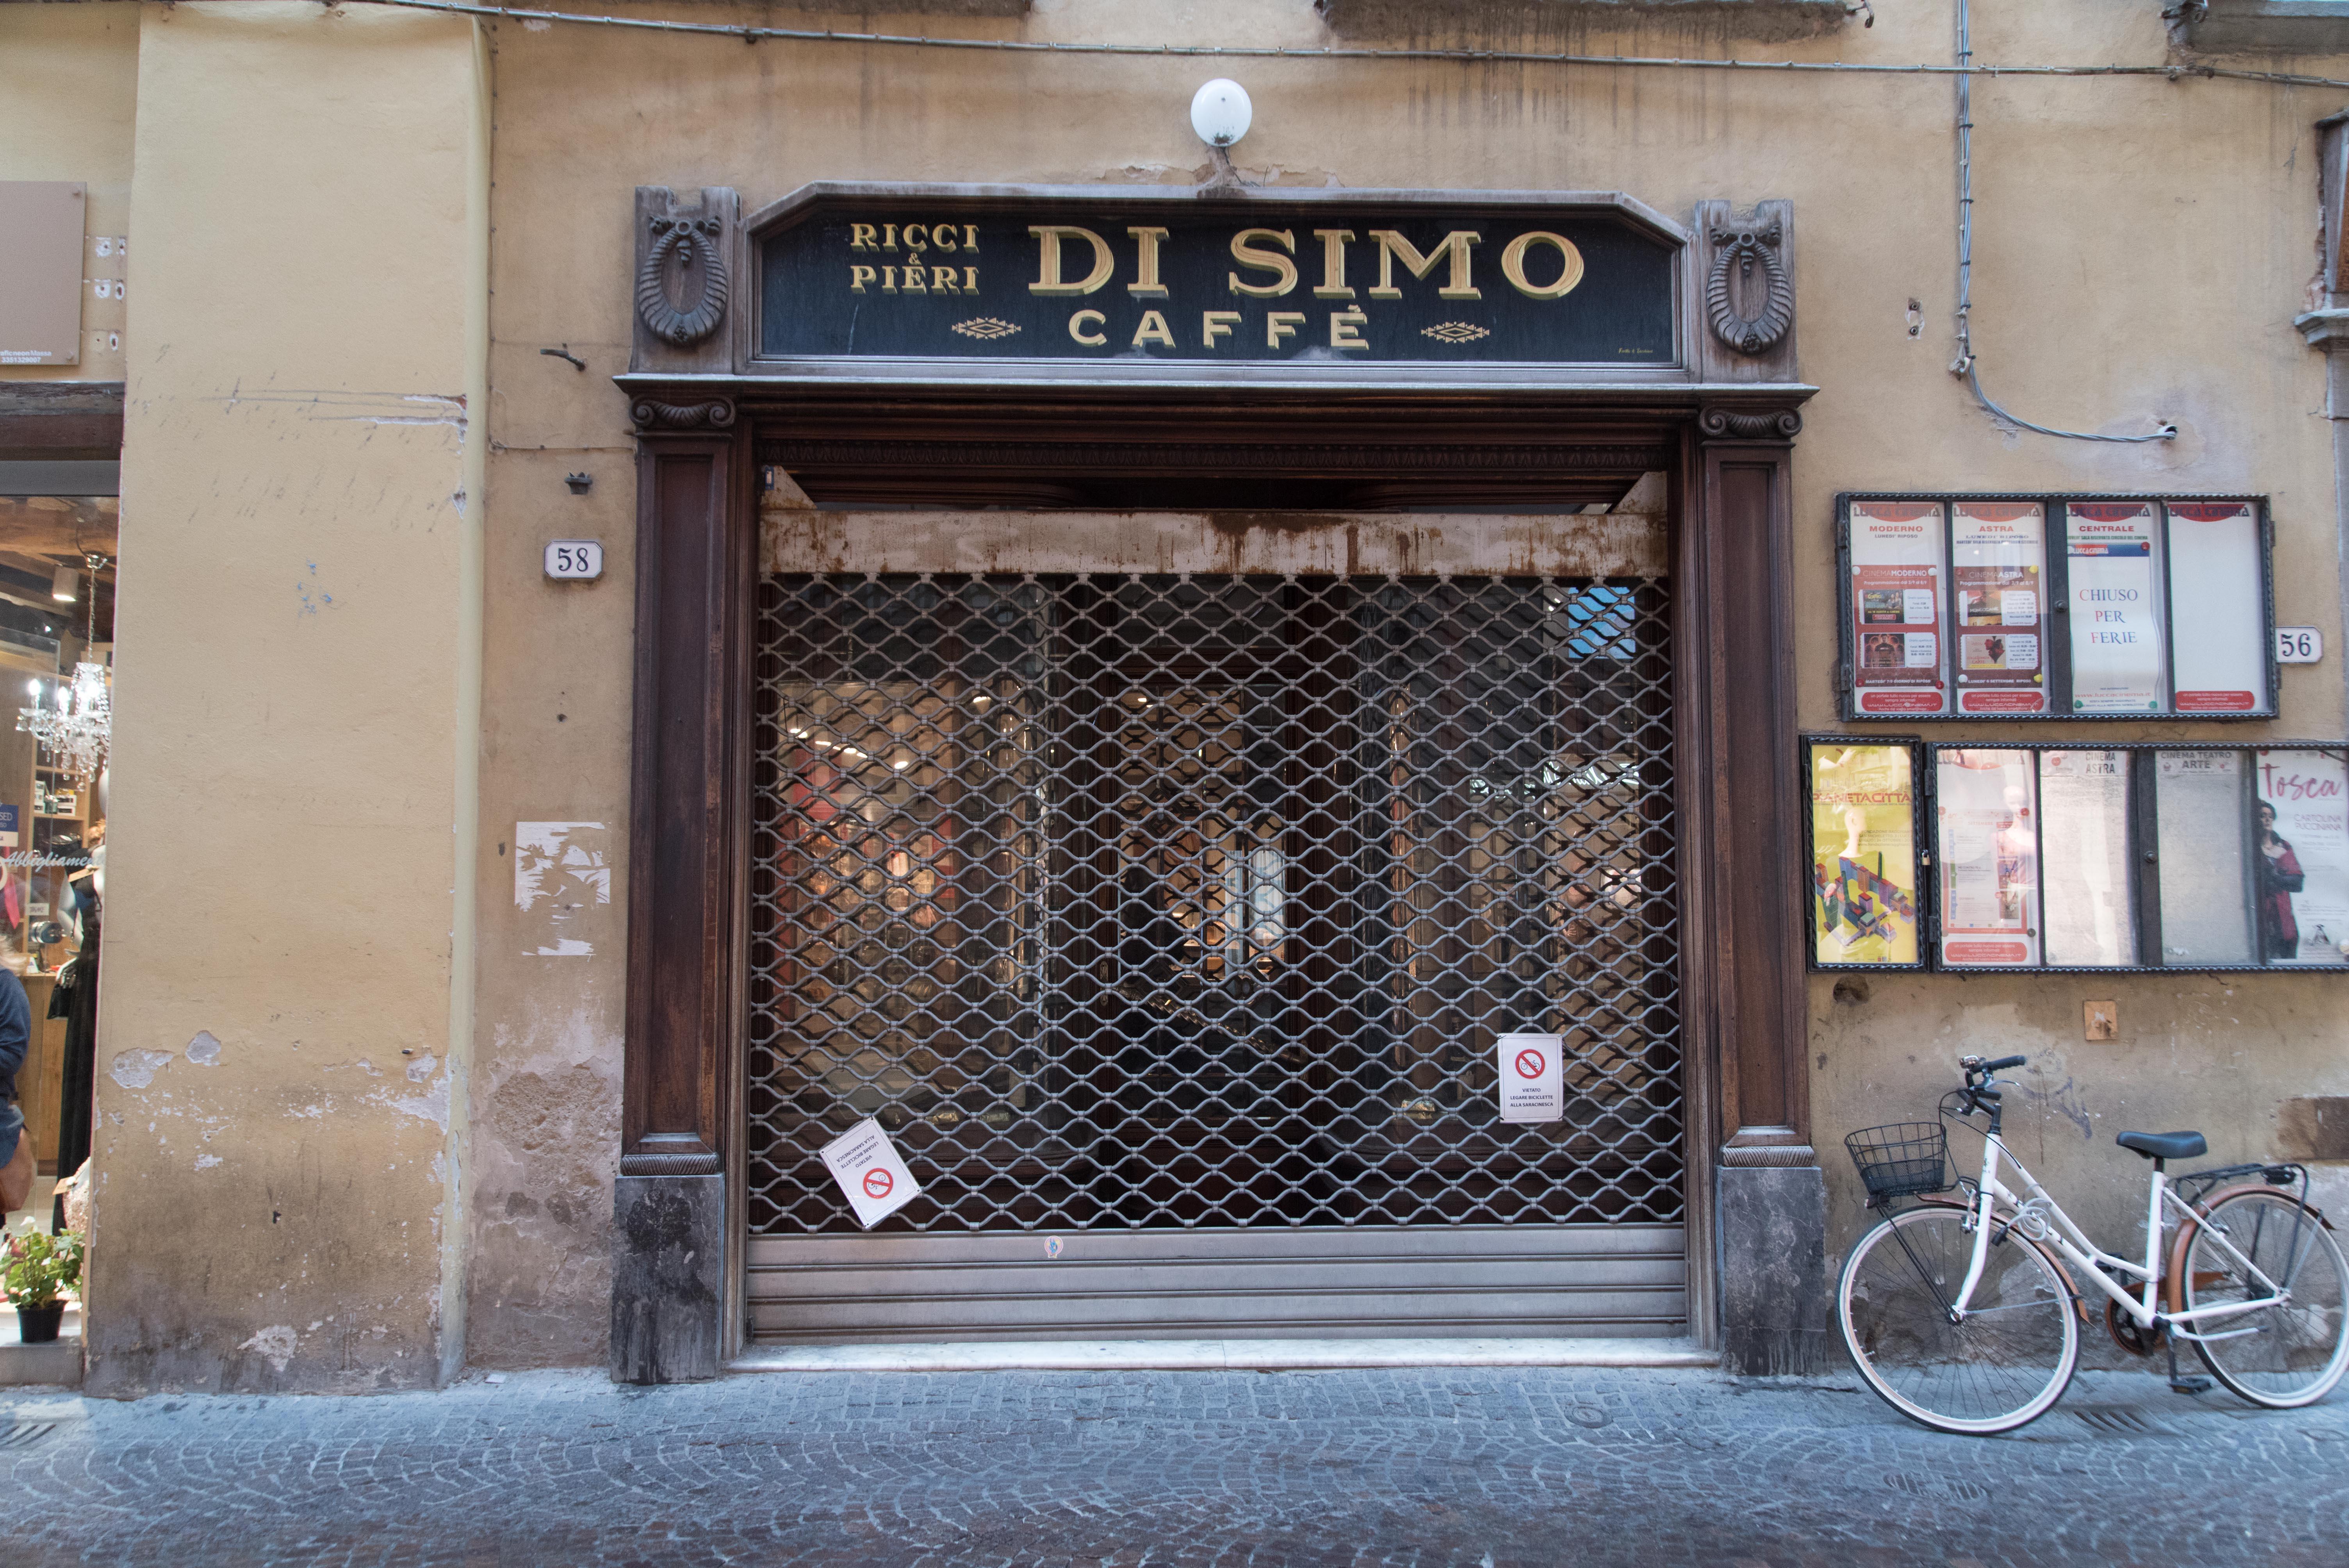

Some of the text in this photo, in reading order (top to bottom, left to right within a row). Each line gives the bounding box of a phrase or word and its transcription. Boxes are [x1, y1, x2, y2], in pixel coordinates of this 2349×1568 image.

[850, 223, 980, 254] RICCI
[908, 252, 922, 266] &
[1028, 225, 1585, 301] DI SIMO
[850, 265, 980, 295] PIERI
[1068, 304, 1369, 351] CAFFÈ
[558, 547, 588, 572] 58
[2079, 588, 2138, 602] CHIUSO
[2095, 610, 2126, 624] PER
[2091, 631, 2137, 644] FERIE
[2280, 633, 2311, 657] 56
[2085, 752, 2116, 761] CINEMA
[2181, 760, 2211, 769] ARTE
[2085, 763, 2115, 774] ASTRA
[836, 1135, 875, 1163] ALLA SARACINESCA
[841, 1141, 879, 1169] LEGARE BICICLETTE
[855, 1155, 873, 1168] VIETATO
